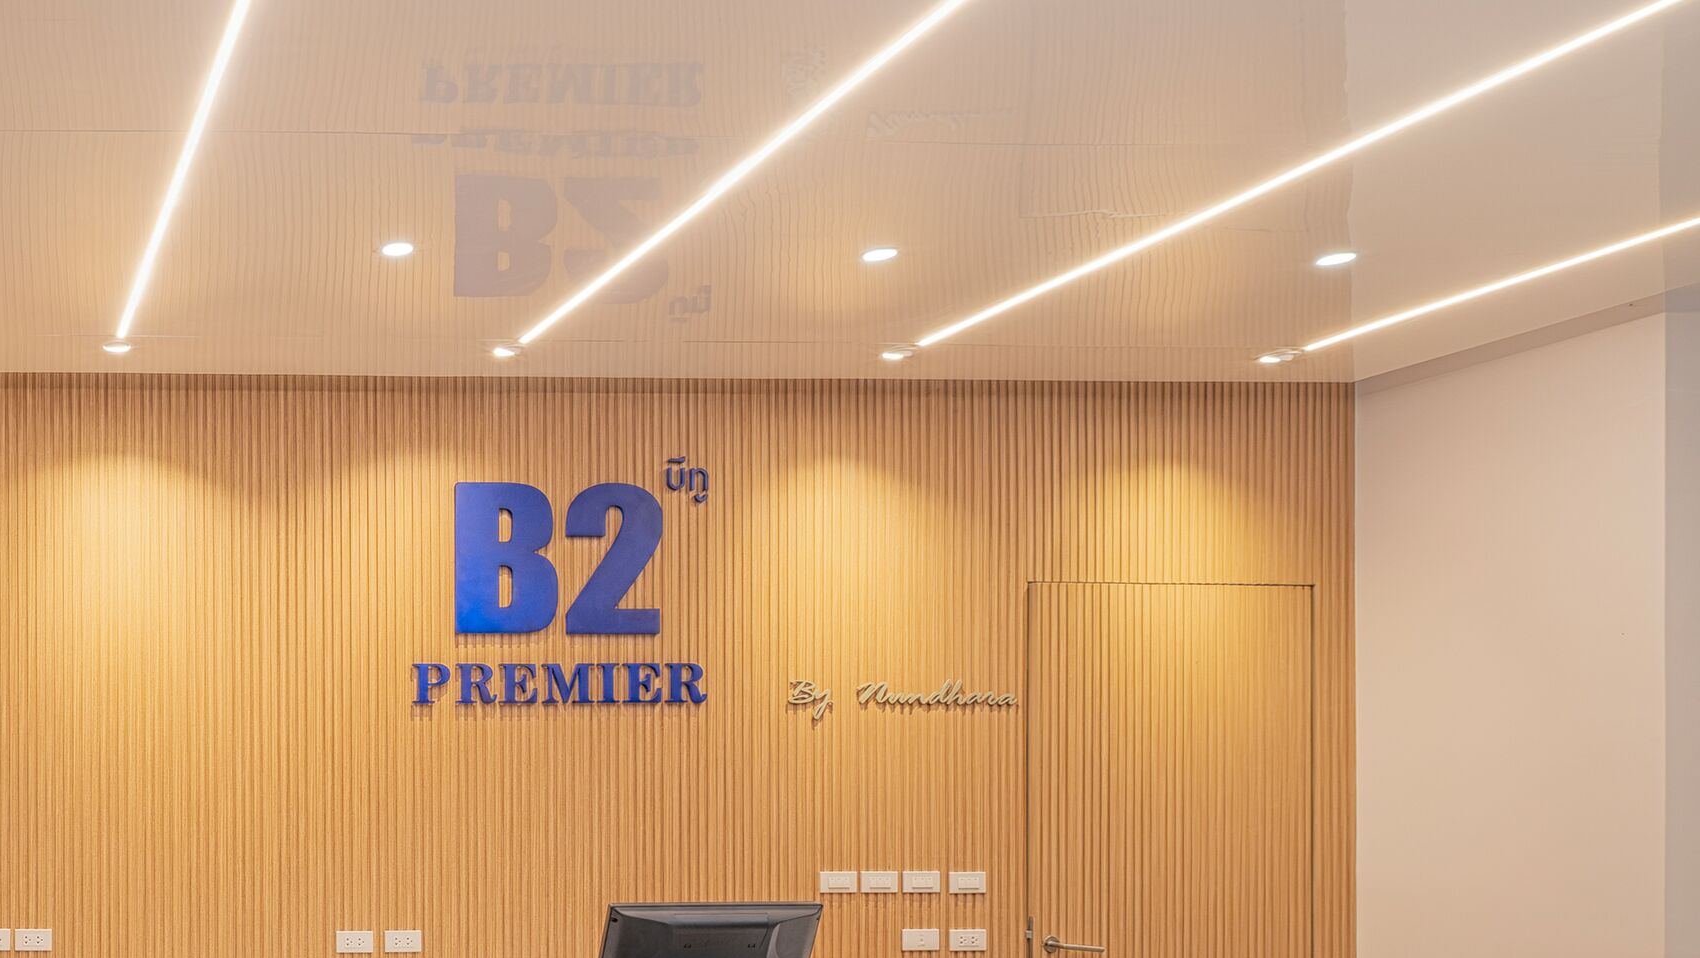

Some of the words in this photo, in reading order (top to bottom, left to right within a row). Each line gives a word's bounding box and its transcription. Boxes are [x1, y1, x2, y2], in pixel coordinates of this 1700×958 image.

[666, 456, 709, 503] บีทู
[454, 481, 664, 636] B2
[411, 661, 708, 706] PREMIER
[788, 679, 833, 720] By
